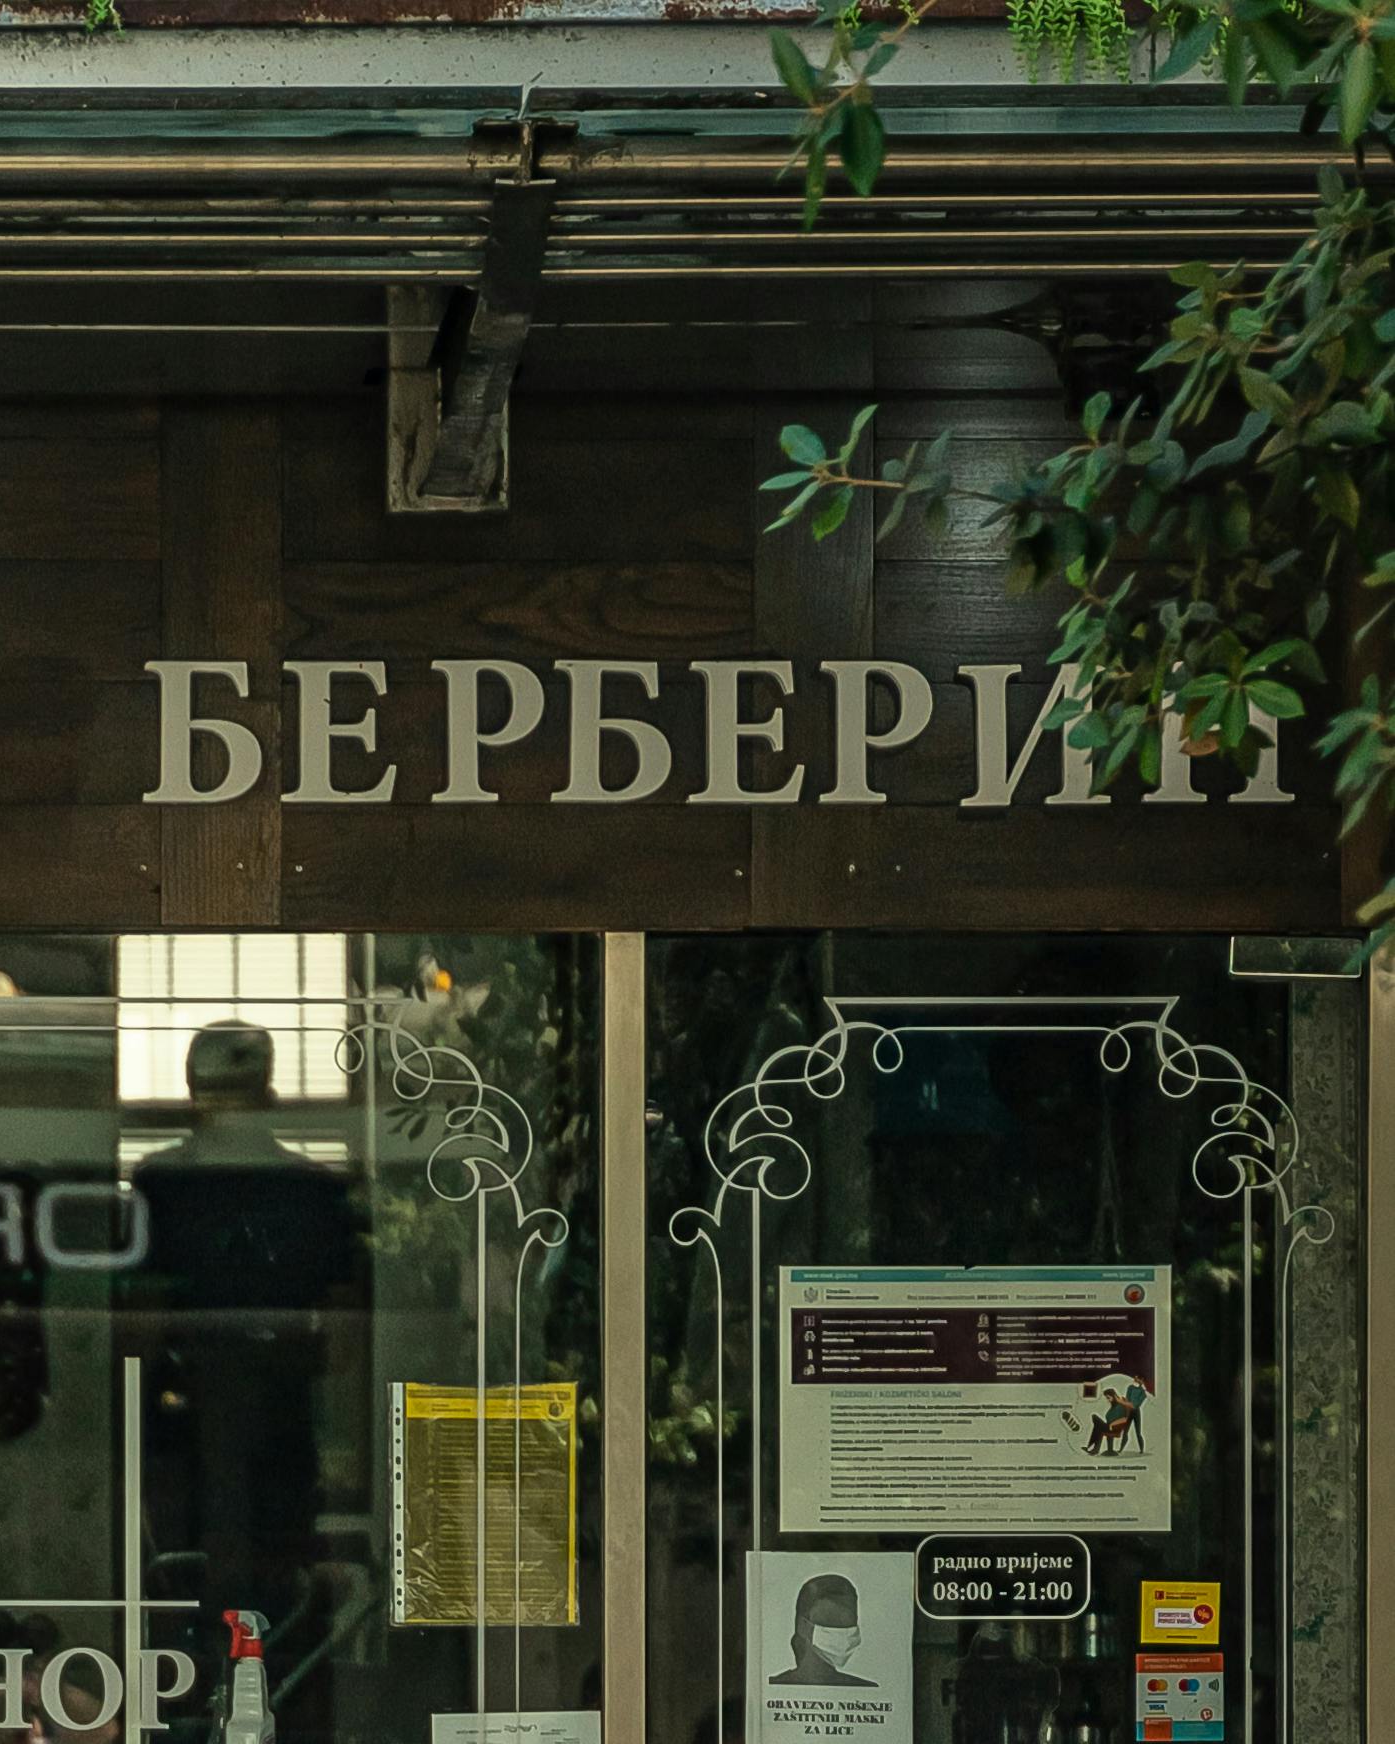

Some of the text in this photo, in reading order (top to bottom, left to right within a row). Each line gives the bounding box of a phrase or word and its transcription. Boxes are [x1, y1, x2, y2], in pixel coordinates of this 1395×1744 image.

[933, 1552, 1073, 1574] радно вријеме
[933, 1581, 993, 1601] 08:00
[1013, 1581, 1073, 1601] 21:00
[844, 1714, 885, 1725] MASKI
[804, 1725, 854, 1736] ZA LICE
